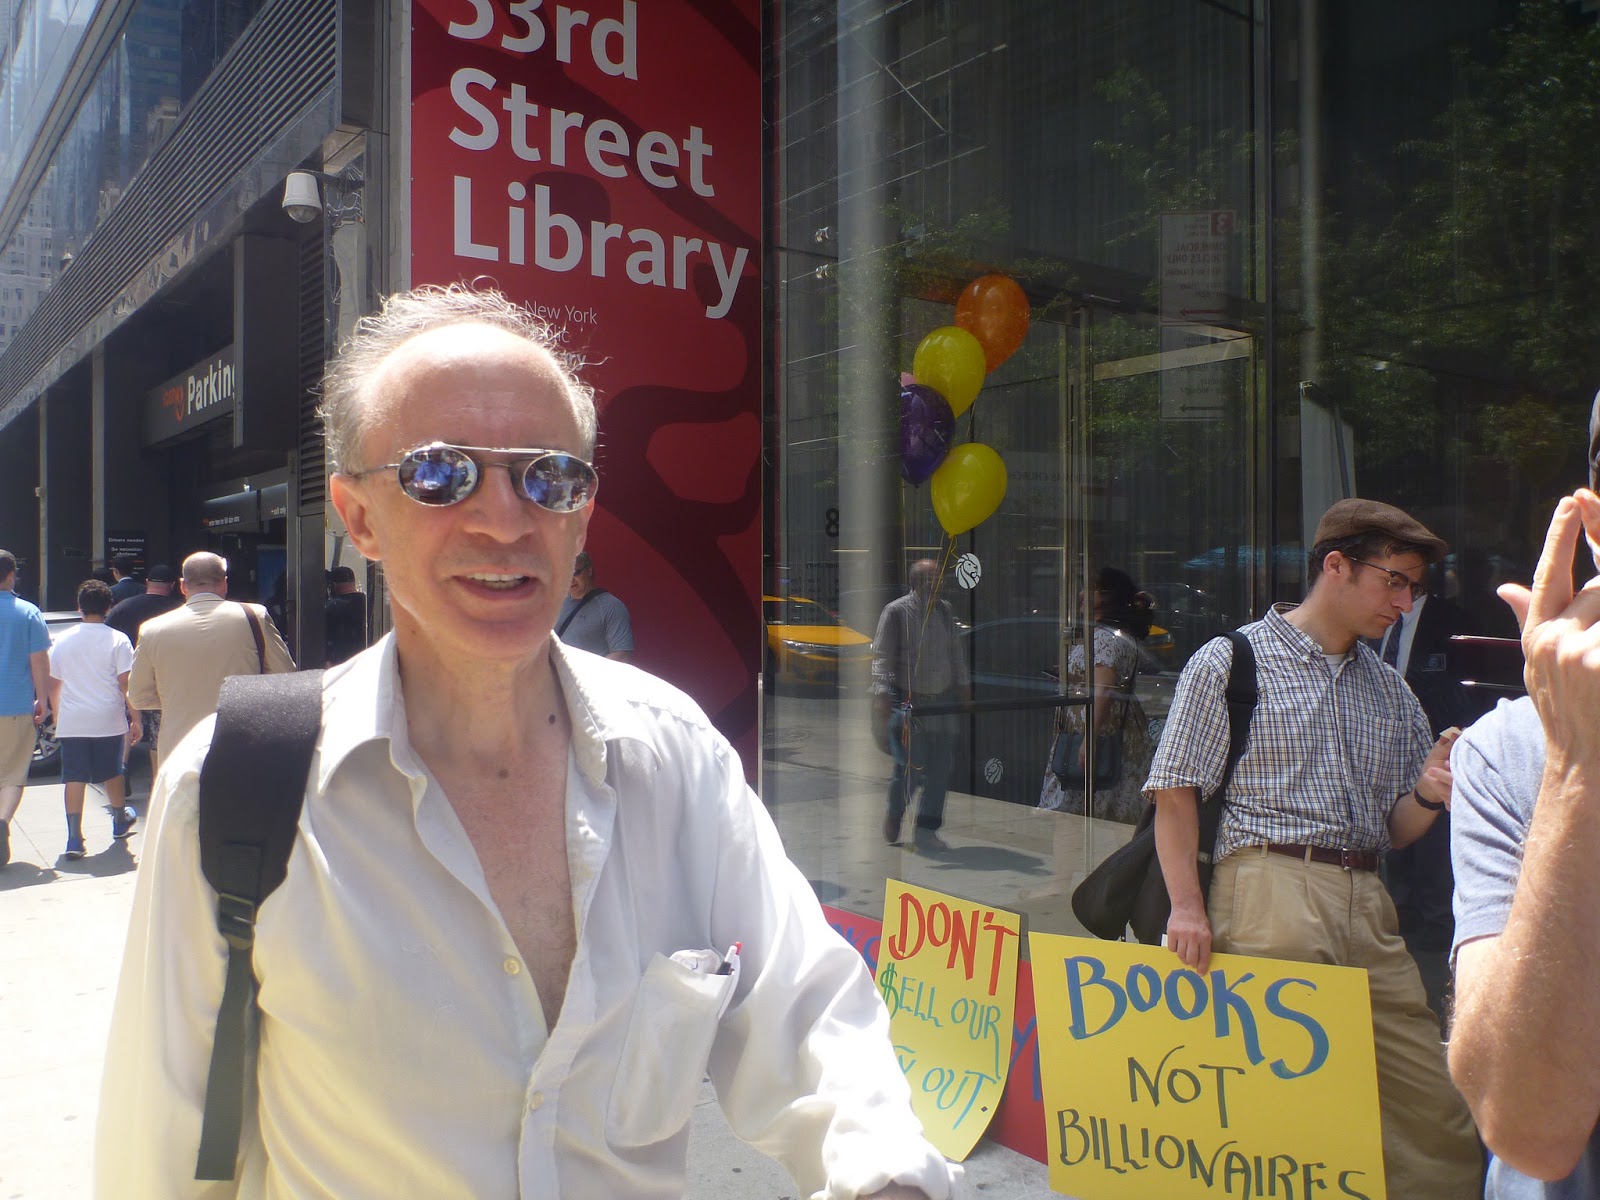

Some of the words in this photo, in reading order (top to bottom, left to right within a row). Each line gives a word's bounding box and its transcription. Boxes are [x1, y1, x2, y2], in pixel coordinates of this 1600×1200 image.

[448, 67, 715, 197] Street
[453, 175, 749, 319] Library
[524, 300, 561, 320] New
[565, 304, 598, 325] York
[888, 892, 1020, 996] DON'T
[951, 997, 1001, 1080] OUR
[1064, 955, 1330, 1080] BOOKS
[1127, 1045, 1245, 1129] NOT
